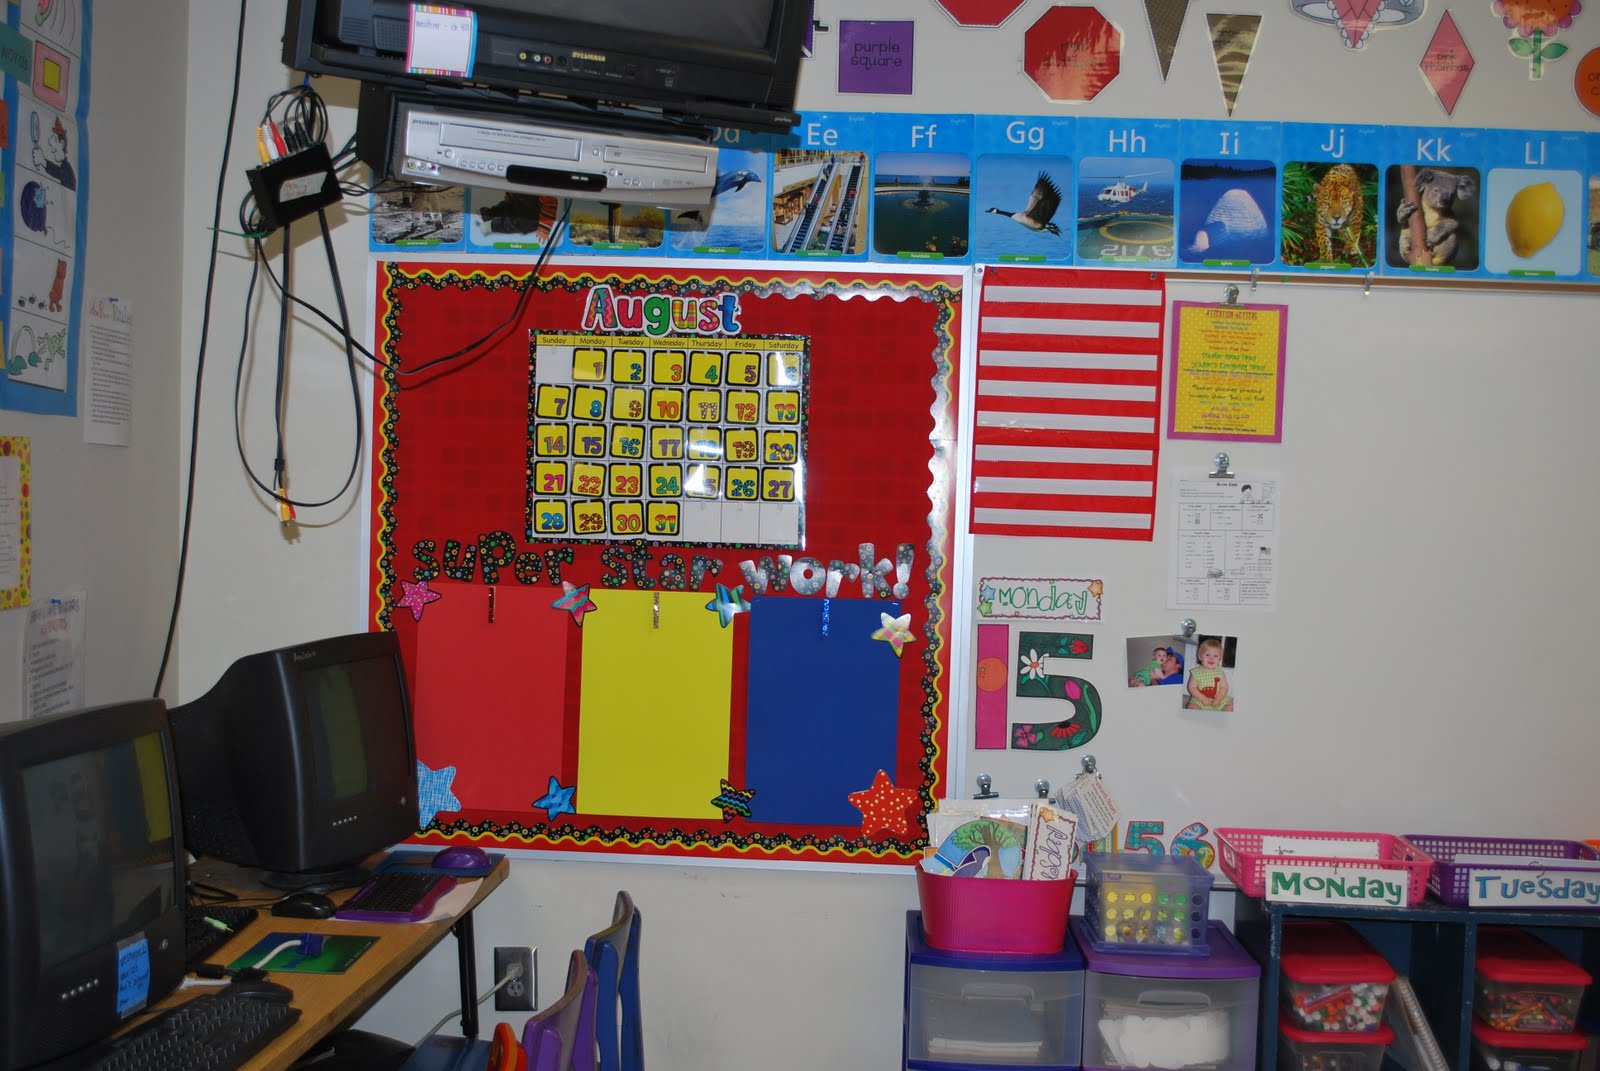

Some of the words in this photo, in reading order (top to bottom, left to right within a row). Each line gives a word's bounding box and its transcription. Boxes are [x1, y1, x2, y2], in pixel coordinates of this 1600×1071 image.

[571, 51, 607, 62] SYLVANIA
[854, 38, 900, 56] purple
[850, 54, 902, 70] square
[807, 123, 839, 147] Ee
[911, 124, 937, 148] Ff
[1006, 121, 1045, 150] Gg
[1109, 129, 1147, 153] Hh
[1219, 132, 1239, 155] Ii
[1321, 128, 1345, 158] Jj
[1416, 137, 1452, 162] Kk
[1525, 141, 1546, 165] Ll
[582, 286, 742, 337] August
[542, 336, 567, 345] Sunday
[579, 337, 606, 346] Monday
[617, 338, 644, 347] Tuesday
[652, 339, 685, 347] Wednesday
[691, 340, 723, 348] Thursday
[735, 341, 756, 349] Friday
[768, 342, 799, 350] Saturday
[593, 362, 602, 379] 1
[630, 363, 642, 381] 2
[670, 364, 683, 381] 3
[704, 364, 718, 383] 4
[744, 365, 757, 383] 5
[554, 398, 566, 416] 7
[589, 400, 602, 417] 8
[629, 400, 642, 417] 9
[657, 401, 680, 418] 10
[698, 402, 718, 420] 11
[735, 403, 757, 421] 12
[774, 403, 796, 421] 13
[544, 436, 565, 453] 14
[582, 437, 602, 454] 15
[619, 438, 641, 455] 16
[658, 439, 681, 457] 17
[732, 441, 755, 458] 19
[769, 443, 794, 461] 20
[543, 473, 564, 491] 21
[577, 475, 601, 494] 22
[615, 475, 638, 493] 23
[655, 476, 680, 494] 24
[731, 479, 755, 497] 26
[768, 480, 792, 498] 27
[541, 512, 565, 530] 28
[578, 513, 603, 531] 29
[616, 513, 641, 531] 30
[655, 514, 676, 531] 31
[600, 539, 723, 590] star
[738, 542, 915, 599] work!
[998, 579, 1089, 616] Monday
